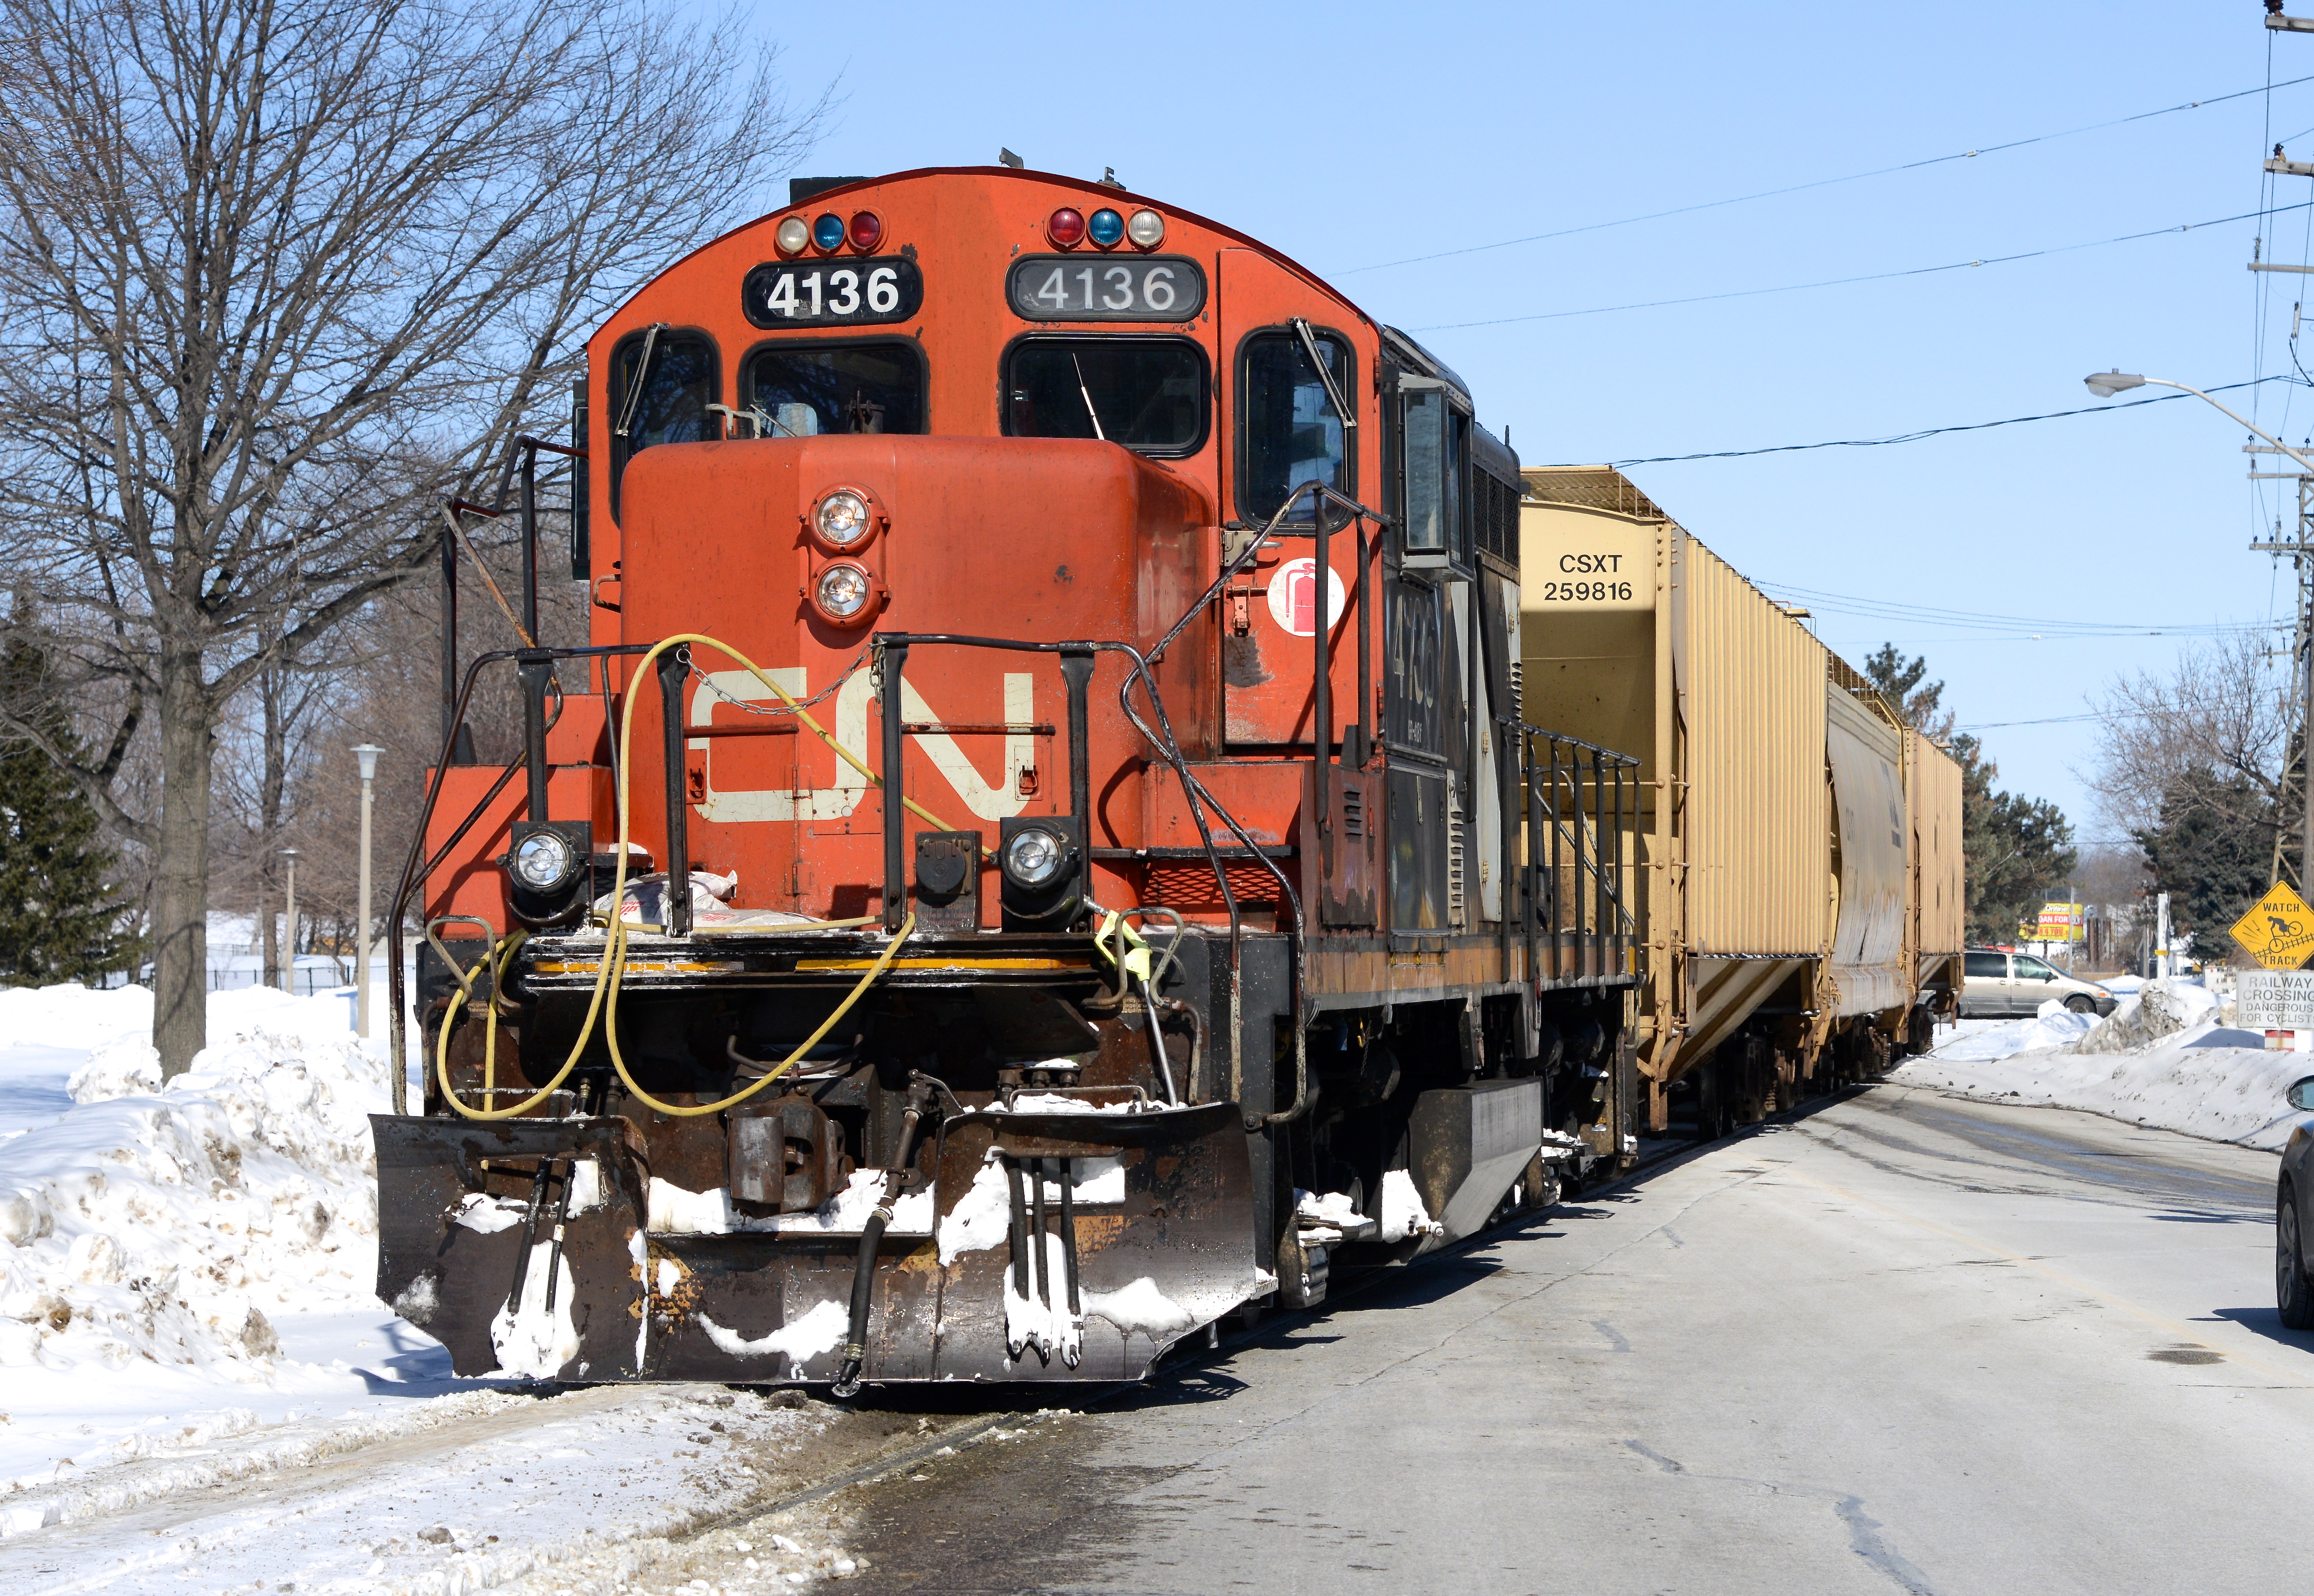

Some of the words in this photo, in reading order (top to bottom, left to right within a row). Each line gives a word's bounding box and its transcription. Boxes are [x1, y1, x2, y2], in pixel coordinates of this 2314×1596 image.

[767, 268, 899, 317] 4136
[1038, 266, 1175, 311] 4136
[1559, 554, 1622, 573] CSXT
[1544, 582, 1632, 601] 259816
[1393, 595, 1435, 709] 4136
[688, 666, 1034, 822] CN
[2263, 902, 2299, 912] WATCH
[2264, 955, 2297, 965] TRACK
[2249, 976, 2312, 989] RAILWAY
[2246, 1003, 2314, 1013] DANGEROUS
[2240, 1013, 2261, 1022] FOR
[2267, 1013, 2314, 1023] CYCLIST
